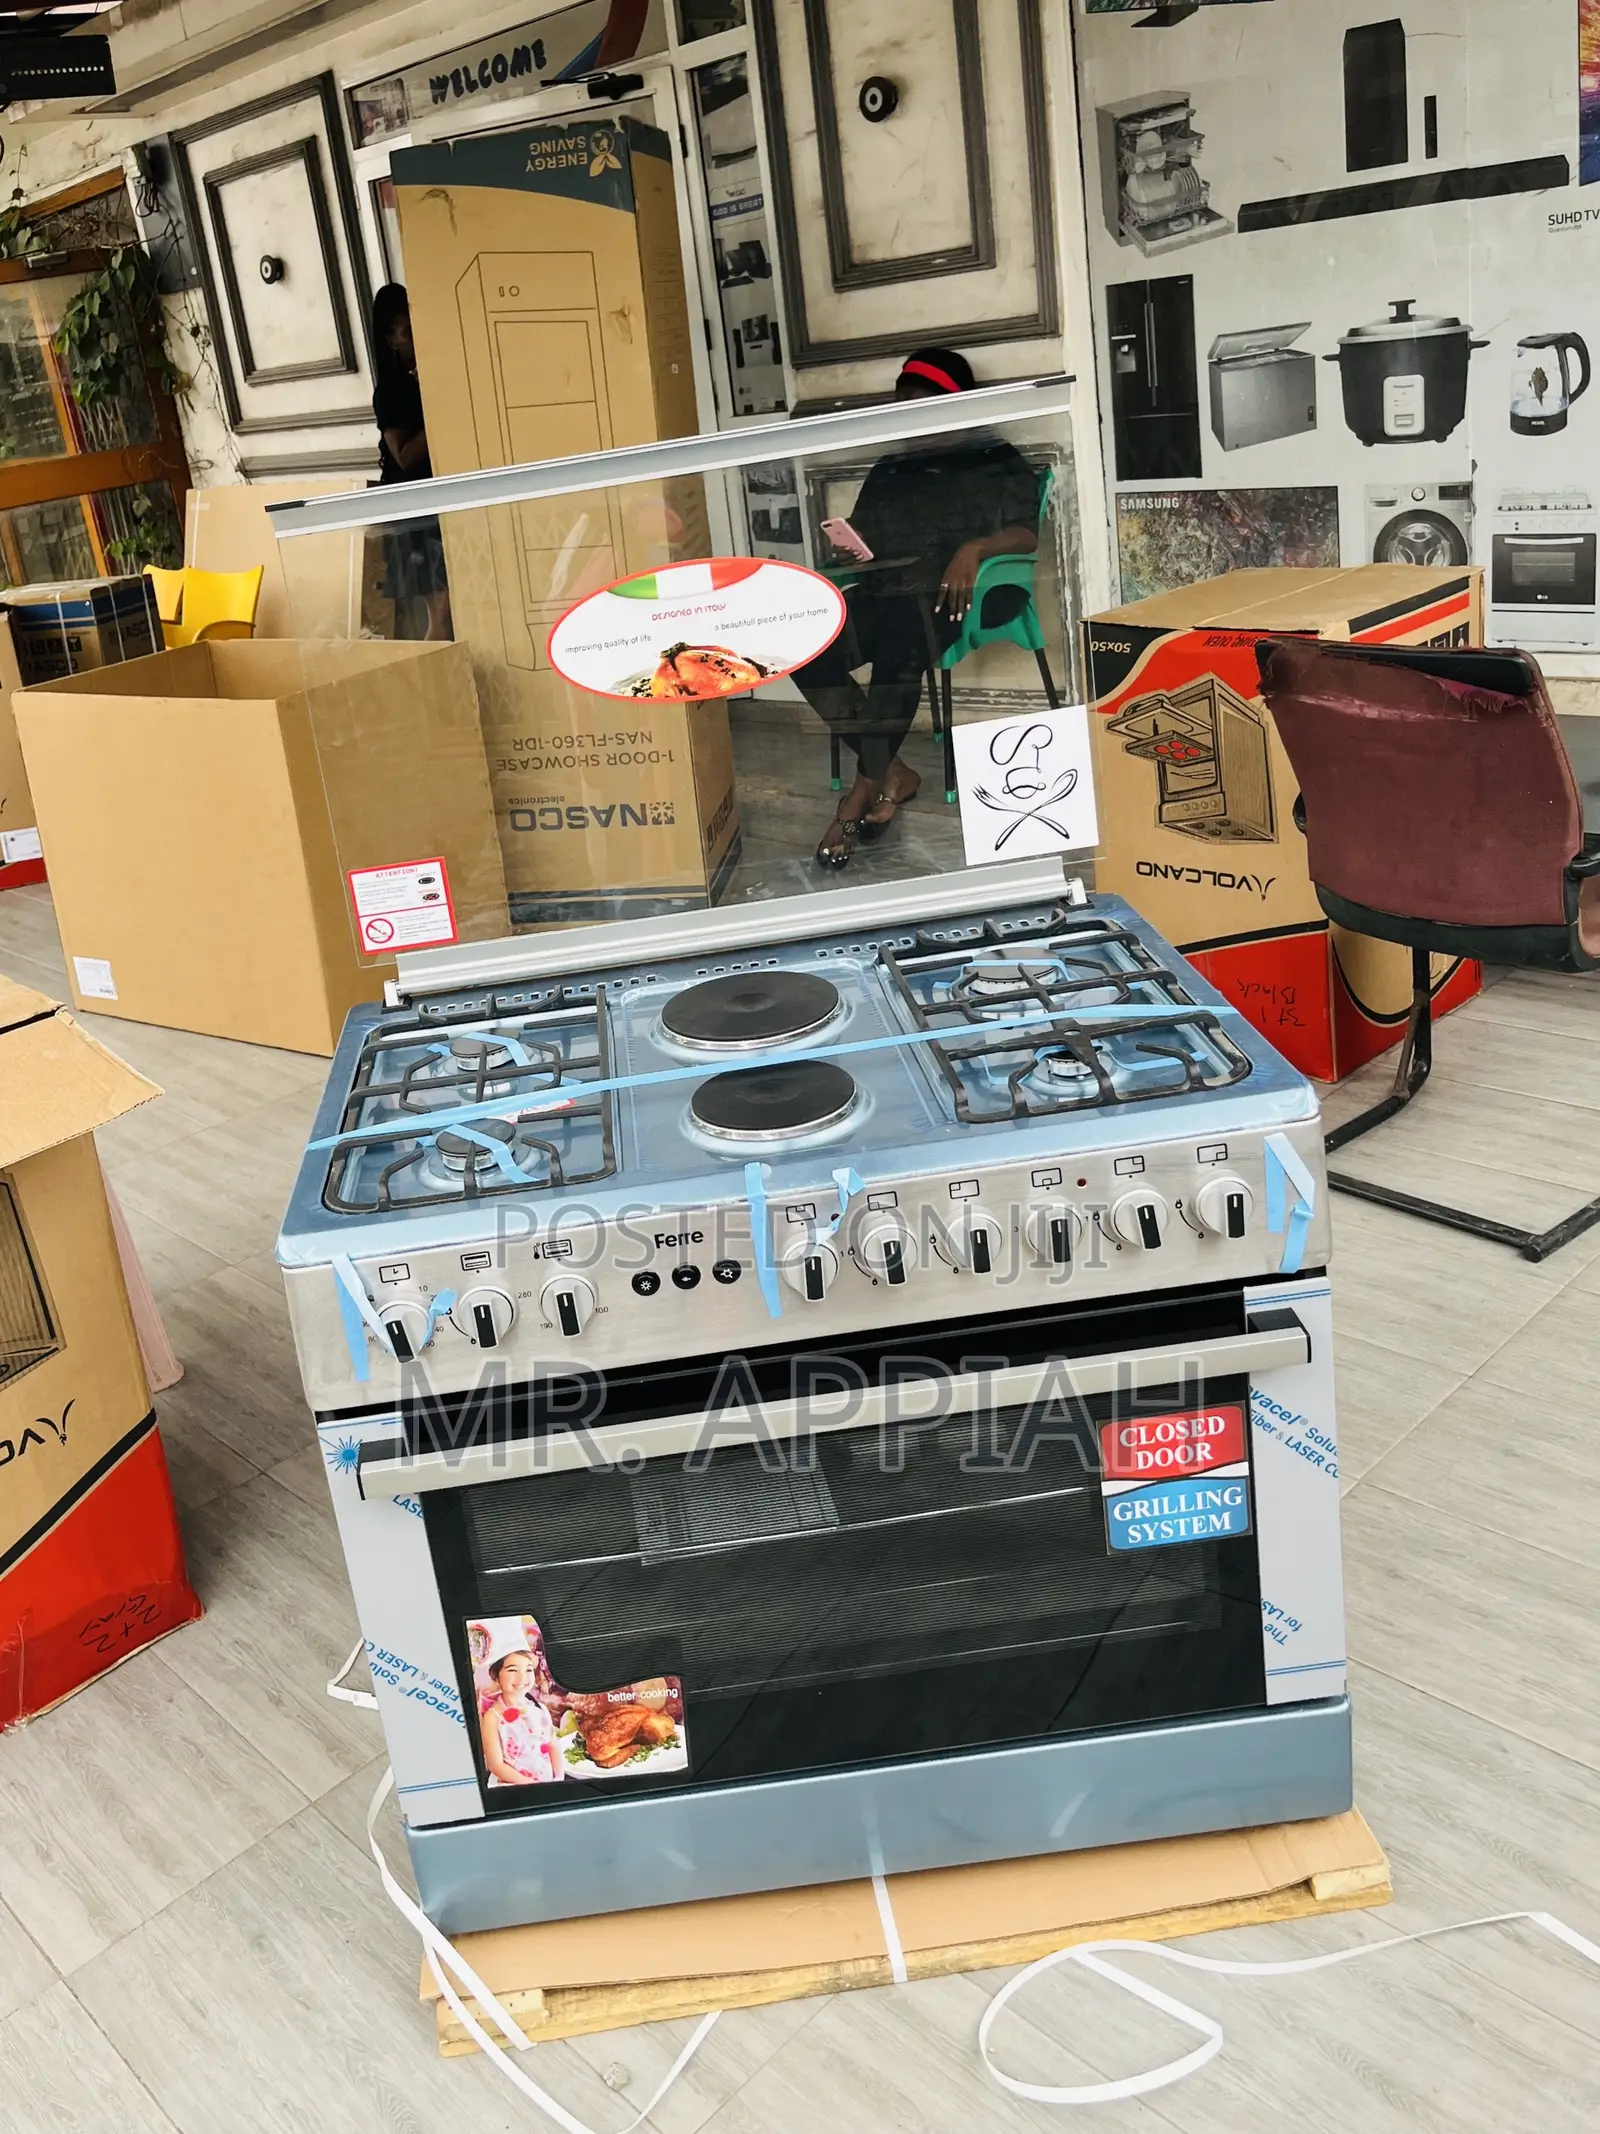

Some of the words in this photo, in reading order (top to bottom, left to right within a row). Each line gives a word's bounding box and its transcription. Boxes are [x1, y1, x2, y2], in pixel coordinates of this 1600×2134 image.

[429, 38, 547, 105] WELCOME
[530, 136, 586, 155] SAVING
[525, 152, 588, 173] ENERGY
[1548, 211, 1582, 226] SUHD
[1584, 209, 1600, 221] TV
[1120, 497, 1179, 510] SAMSUNG
[652, 608, 692, 621] DESIGNED
[757, 615, 777, 626] piece
[779, 612, 787, 621] of
[788, 611, 805, 622] your
[807, 606, 828, 616] home
[564, 641, 602, 657] improving
[603, 636, 629, 650] quality
[630, 636, 639, 645] of
[640, 634, 652, 643] life
[512, 730, 653, 751] NAS-FL360-1DR
[496, 753, 600, 771] SHOWCASE
[606, 749, 675, 763] 1-DOOR
[507, 795, 565, 805] electronics
[509, 803, 648, 832] NASCO
[1135, 861, 1253, 892] VOLCANO
[1236, 978, 1297, 1005] Black
[653, 1230, 704, 1249] Ferre
[418, 1285, 428, 1293] 10
[517, 1290, 532, 1299] 280
[540, 1321, 553, 1330] 190
[1119, 1415, 1225, 1447] CLOSED
[1135, 1441, 1214, 1471] DOOR
[1284, 1435, 1325, 1467] LASER
[1113, 1485, 1243, 1522] GRILLING
[1127, 1511, 1232, 1544] SYSTEM
[1264, 1623, 1288, 1646] The
[1283, 1616, 1303, 1632] for
[376, 1648, 419, 1677] LASER
[428, 1678, 460, 1702] Fiber
[607, 1690, 637, 1703] better
[639, 1687, 679, 1704] cooking
